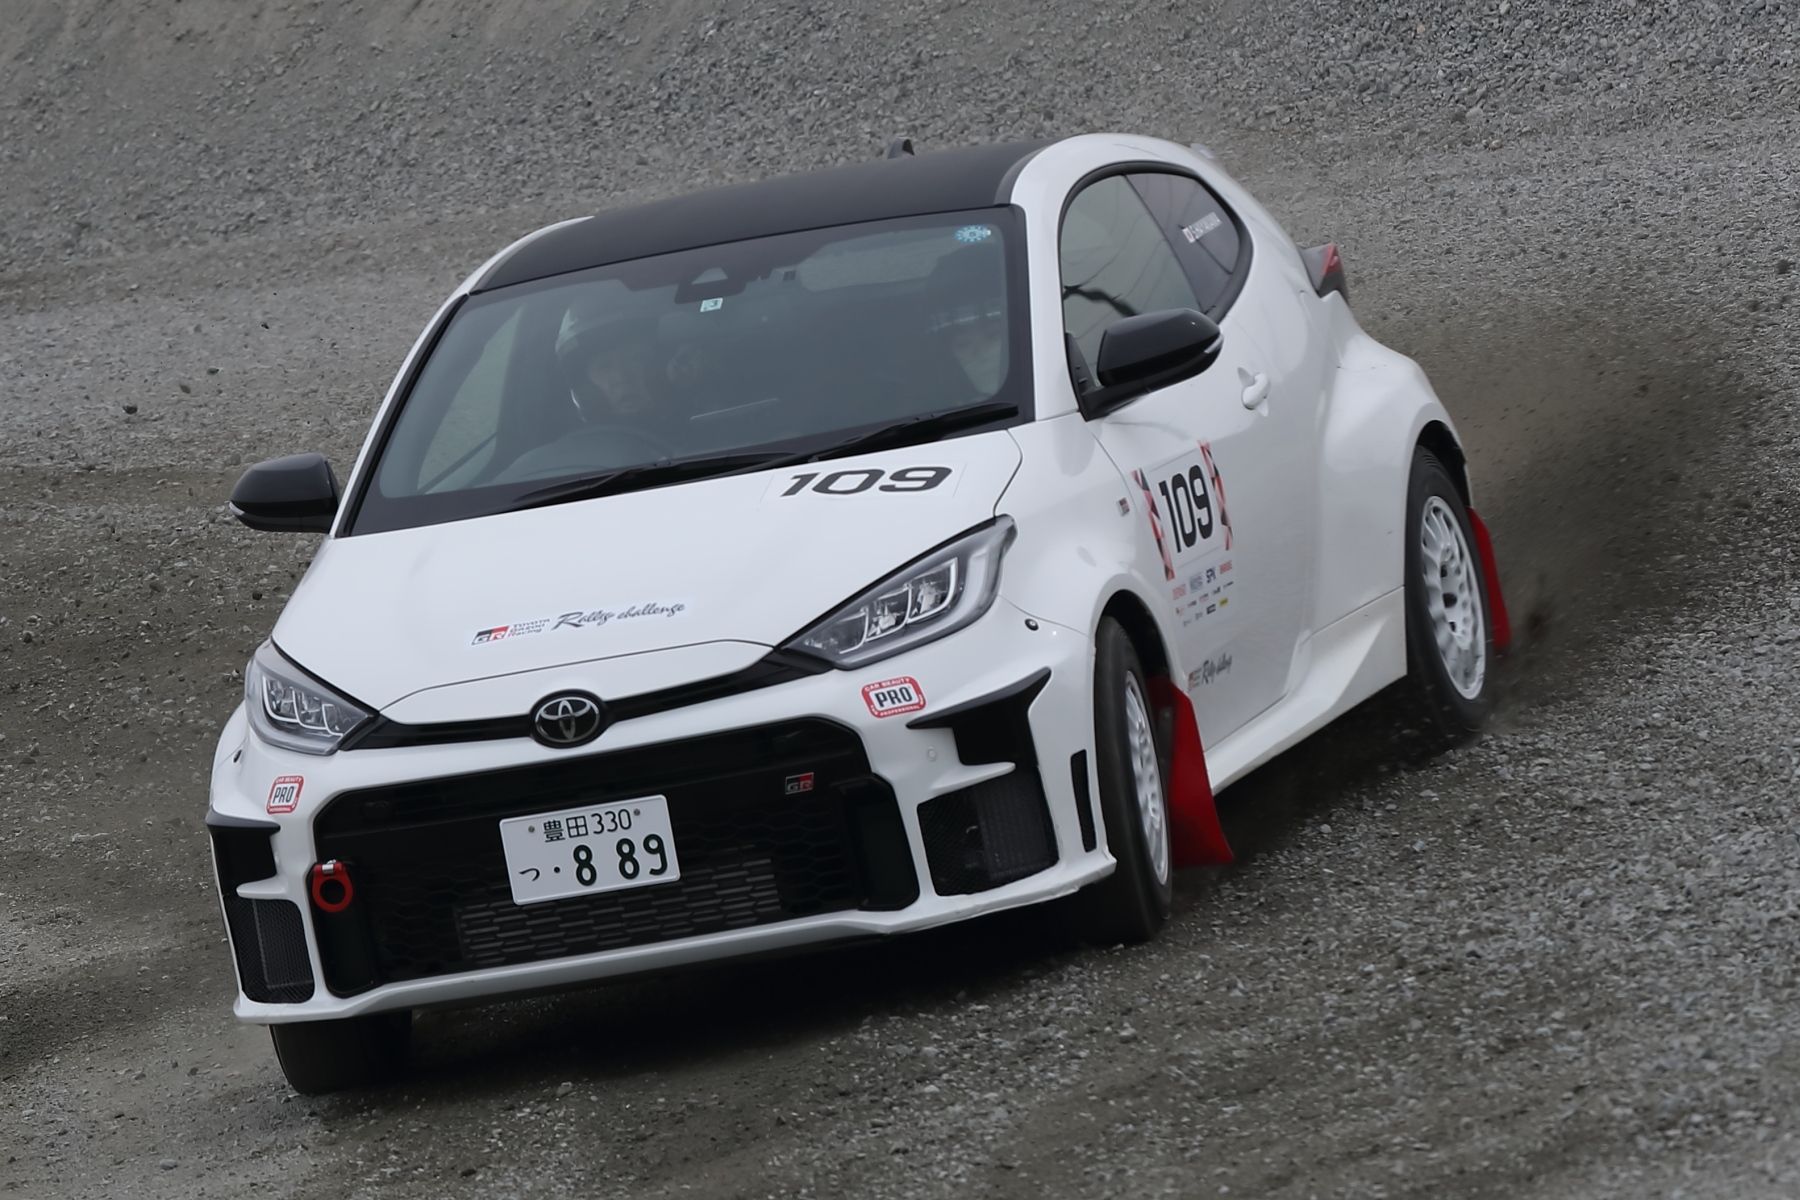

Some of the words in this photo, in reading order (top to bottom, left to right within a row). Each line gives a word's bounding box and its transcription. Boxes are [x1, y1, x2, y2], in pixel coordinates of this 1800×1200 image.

[780, 466, 953, 498] 109
[1158, 464, 1214, 553] 109
[551, 611, 615, 631] Rally
[616, 603, 685, 620] challenge
[874, 686, 913, 708] PRO
[272, 785, 295, 804] PRO
